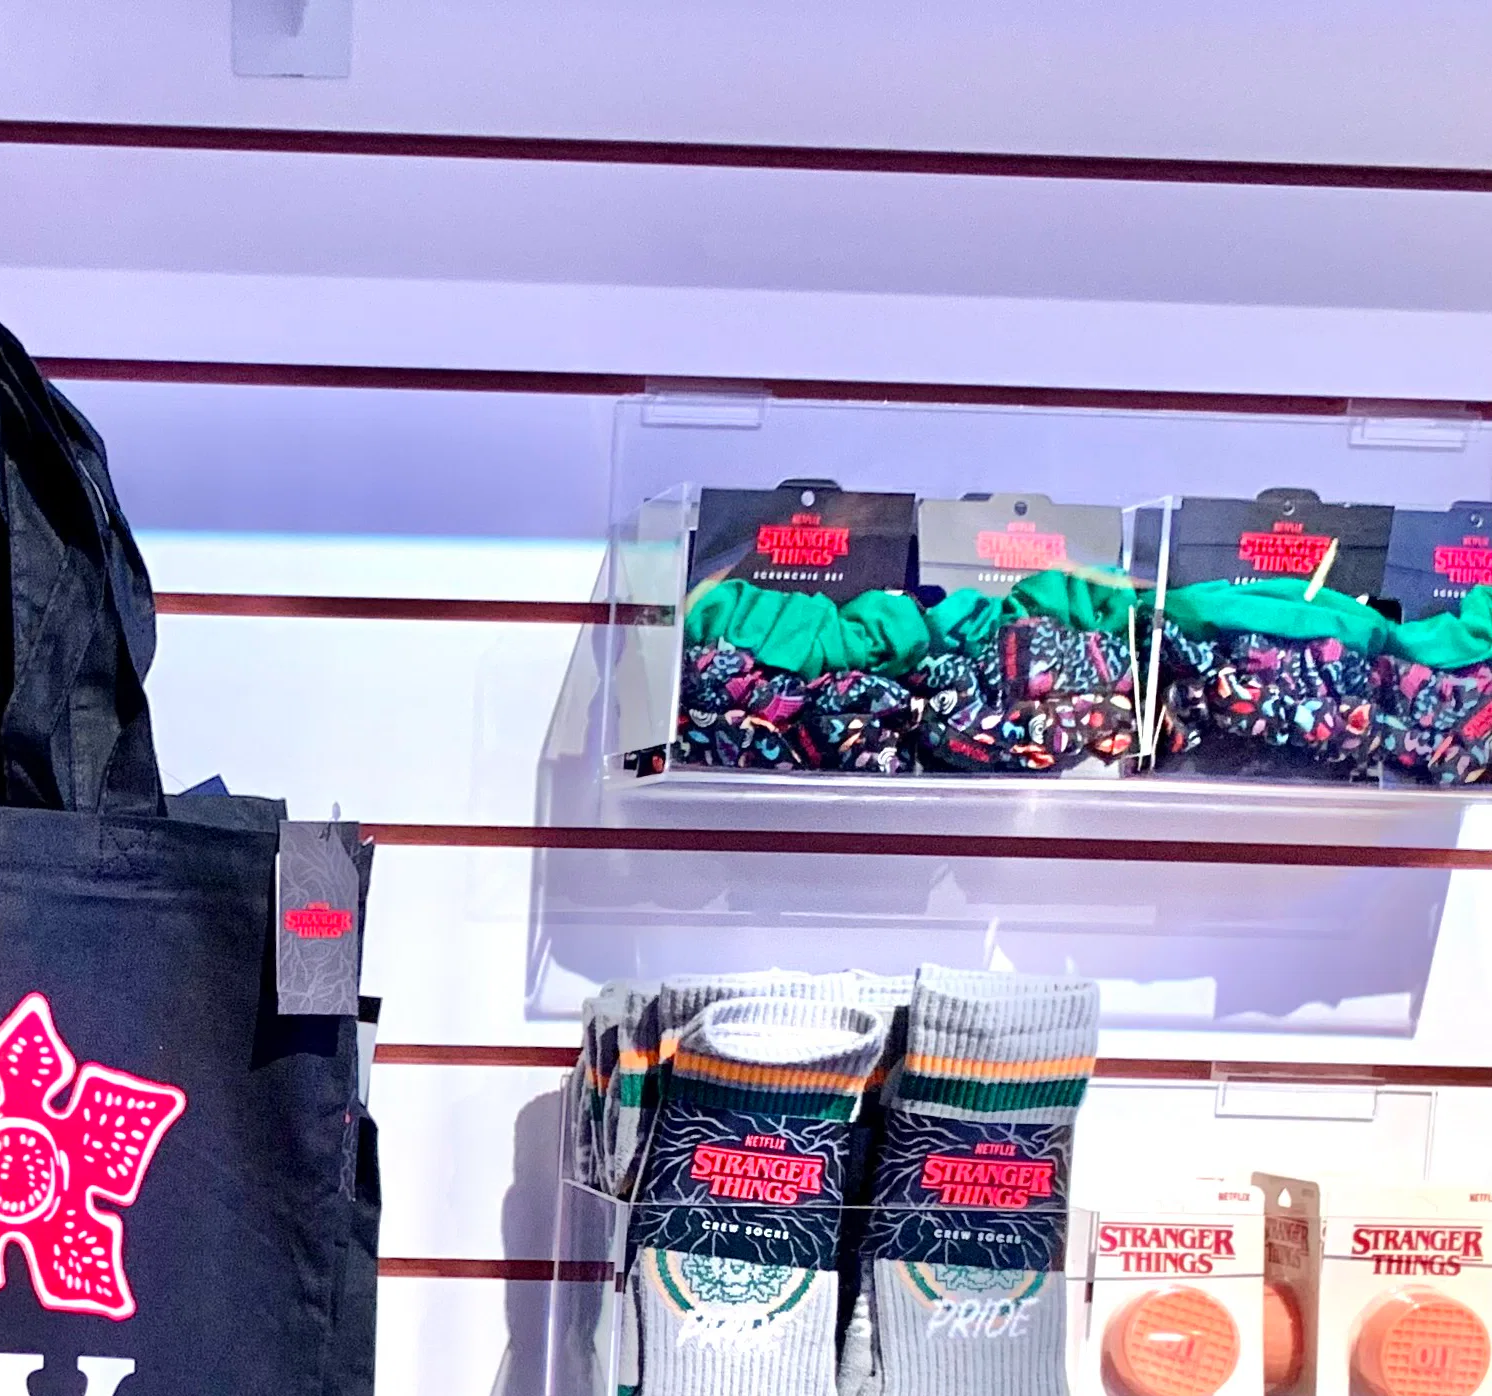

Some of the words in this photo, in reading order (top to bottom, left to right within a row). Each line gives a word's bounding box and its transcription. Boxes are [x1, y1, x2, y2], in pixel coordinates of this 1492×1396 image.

[758, 528, 849, 555] STRANGER
[772, 548, 834, 566] THINGS
[1253, 555, 1314, 574] THINGS
[745, 1134, 786, 1150] NETFLIX
[975, 1143, 1016, 1156] NETFLIX
[691, 1148, 823, 1192] STRANGER
[921, 1158, 1053, 1195] STRANGER
[708, 1176, 798, 1204] THINGS
[939, 1184, 1028, 1209] THINGS
[1218, 1192, 1250, 1202] NETFLIX
[701, 1220, 739, 1234] CREW
[745, 1226, 790, 1241] SOCKS
[933, 1228, 972, 1241] CREW
[977, 1232, 1022, 1245] SOCKS
[1099, 1225, 1236, 1256] STRANGER
[1351, 1228, 1484, 1257] STRANGER
[1119, 1252, 1214, 1274] THINGS
[1371, 1254, 1462, 1276] THINGS
[926, 1297, 1039, 1339] PRIDE
